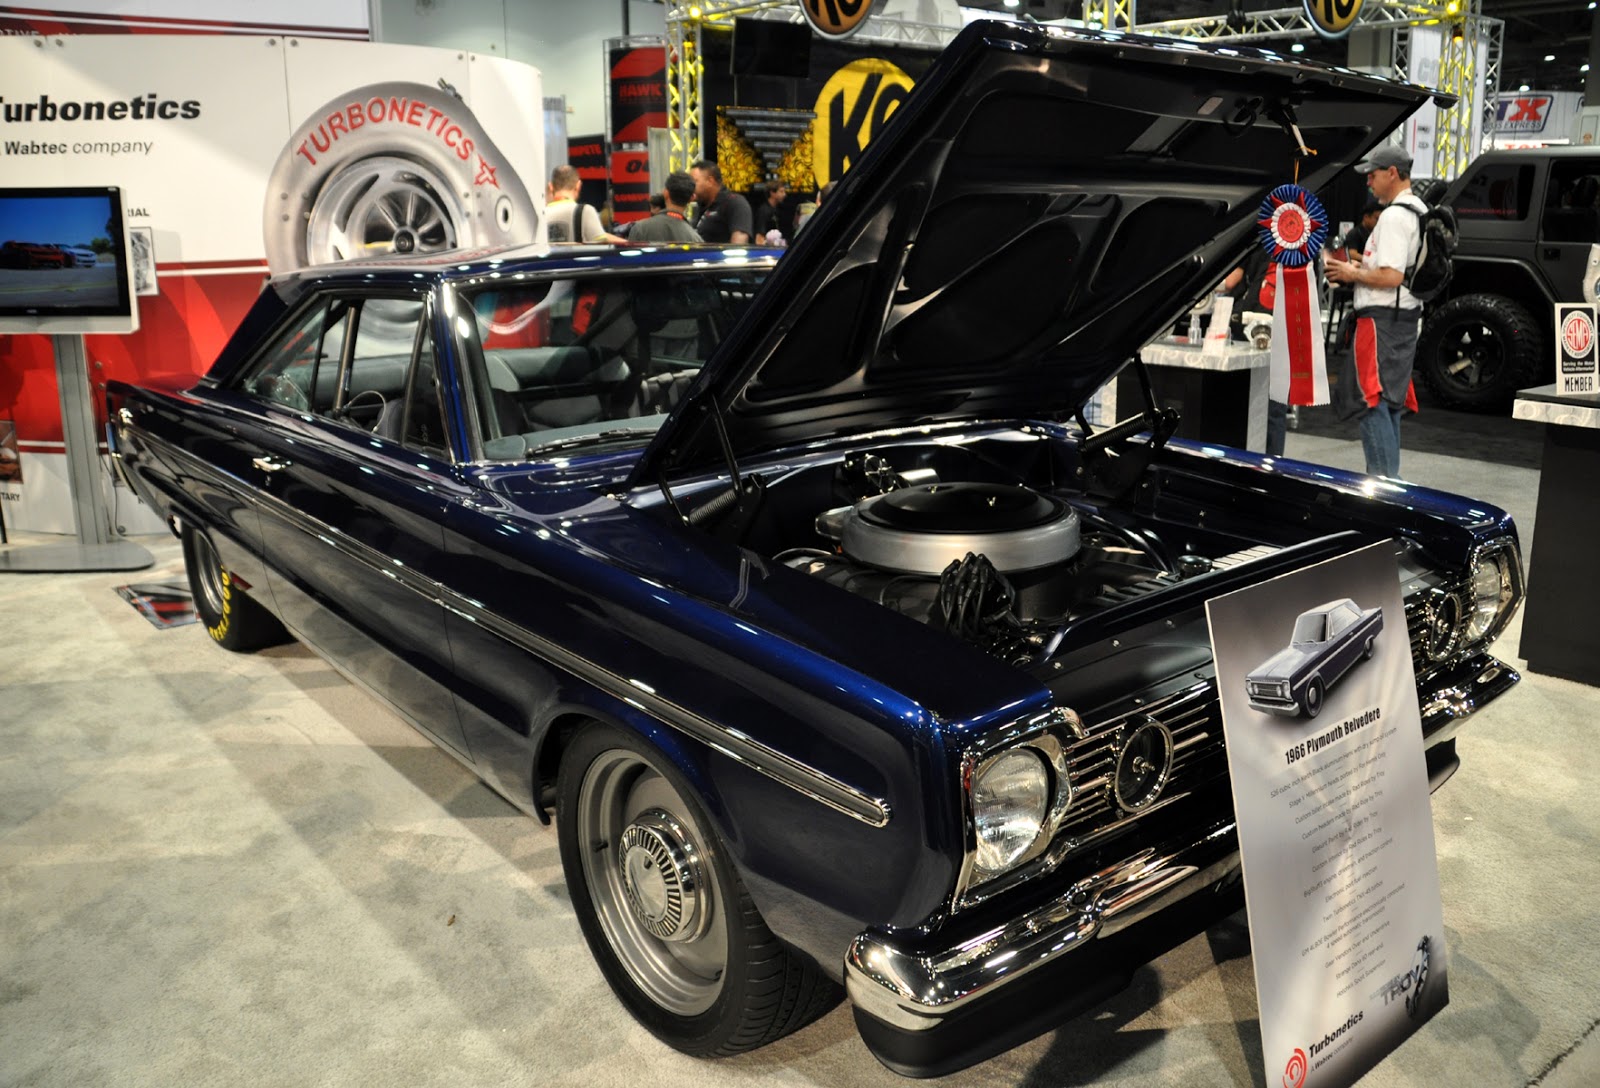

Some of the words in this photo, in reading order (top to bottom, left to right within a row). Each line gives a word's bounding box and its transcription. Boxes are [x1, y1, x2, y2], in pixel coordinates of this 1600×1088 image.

[619, 83, 662, 97] HAWK
[0, 93, 201, 122] urbonetics
[296, 96, 475, 167] TURBONETICS
[5, 141, 67, 155] Wabtec
[72, 141, 153, 156] company
[1565, 376, 1593, 392] MEMBER
[1285, 743, 1306, 765] 1966
[1306, 726, 1343, 754] Plymouth
[1344, 708, 1380, 735] Belvedere
[1288, 797, 1302, 809] Stage
[1301, 827, 1319, 840] Custom
[1334, 811, 1346, 820] made
[1309, 1011, 1363, 1058] Turbonetics
[1314, 1053, 1333, 1069] Wabtec
